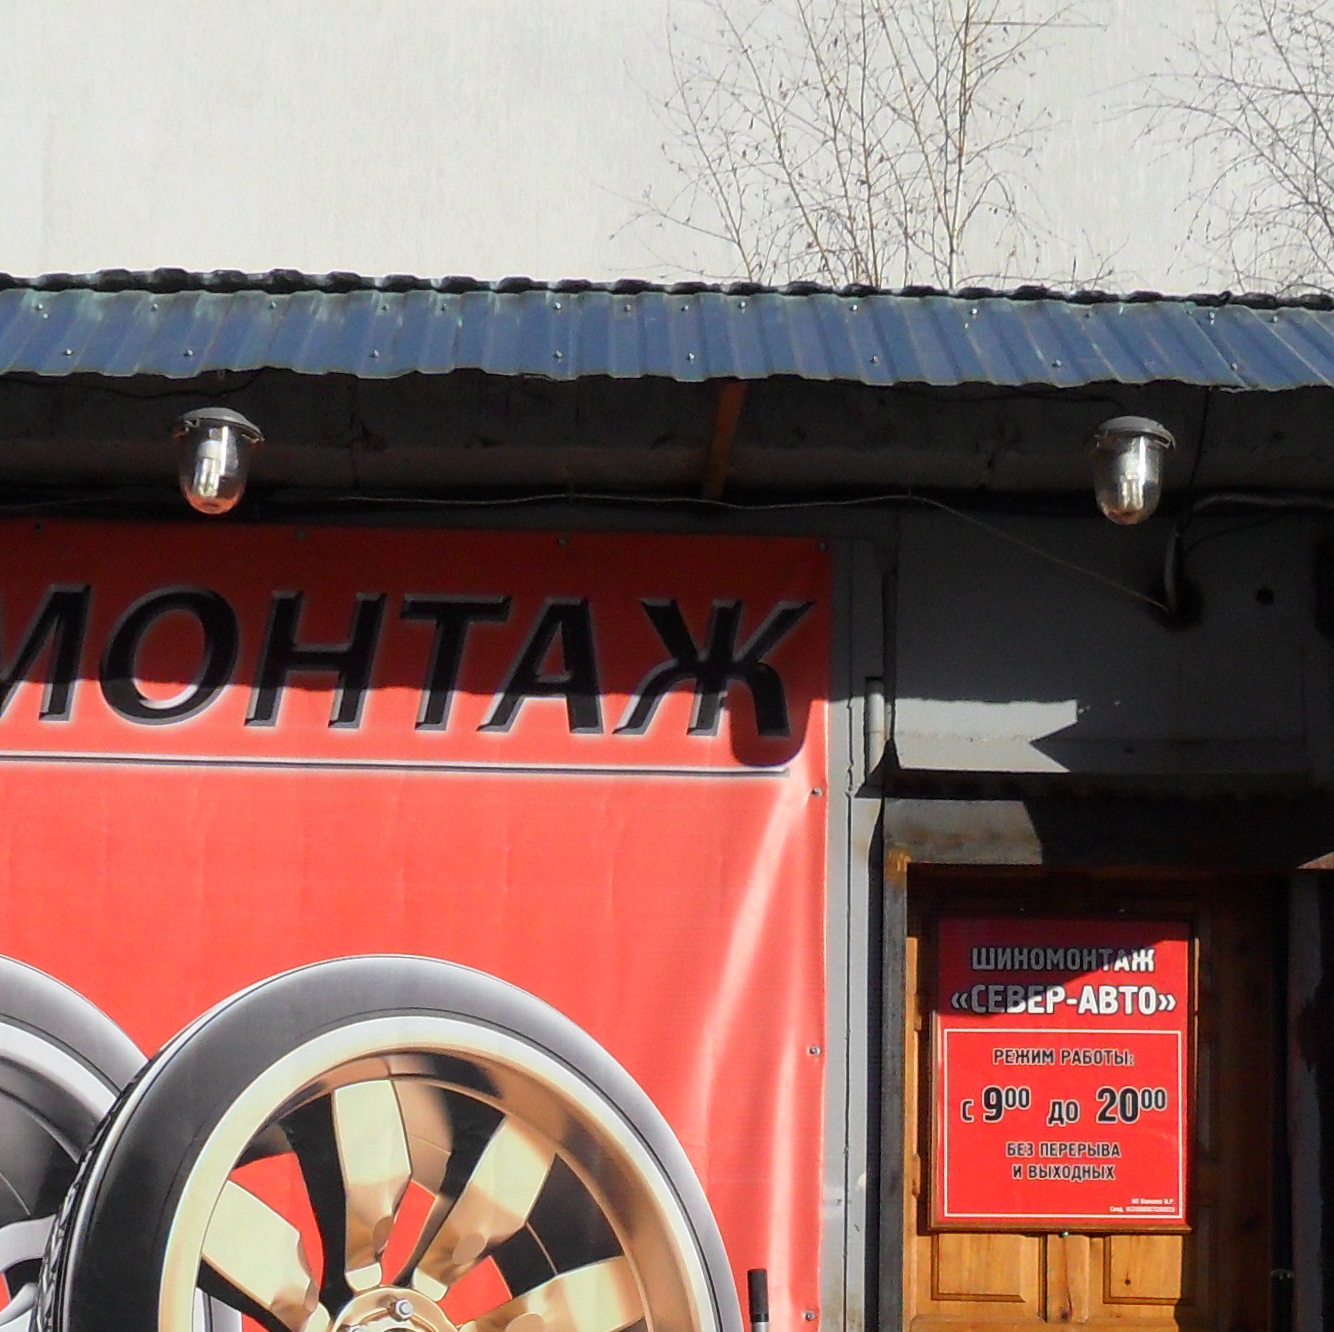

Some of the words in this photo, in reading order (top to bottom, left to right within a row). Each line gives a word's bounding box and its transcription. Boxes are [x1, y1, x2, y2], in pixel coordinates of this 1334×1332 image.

[971, 946, 1155, 972] ШИНОМОНТАЖ
[951, 984, 1176, 1015] «СЕВЕР-АВТО»
[993, 1048, 1055, 1065] РЕЖИМ
[1061, 1049, 1134, 1066] РАБОТЫ:
[1006, 1142, 1033, 1157] БЕЗ
[1040, 1142, 1121, 1158] ПЕРЕРЫВА
[1012, 1164, 1022, 1179] И
[1028, 1164, 1115, 1182] ВЫХОДНЫХ
